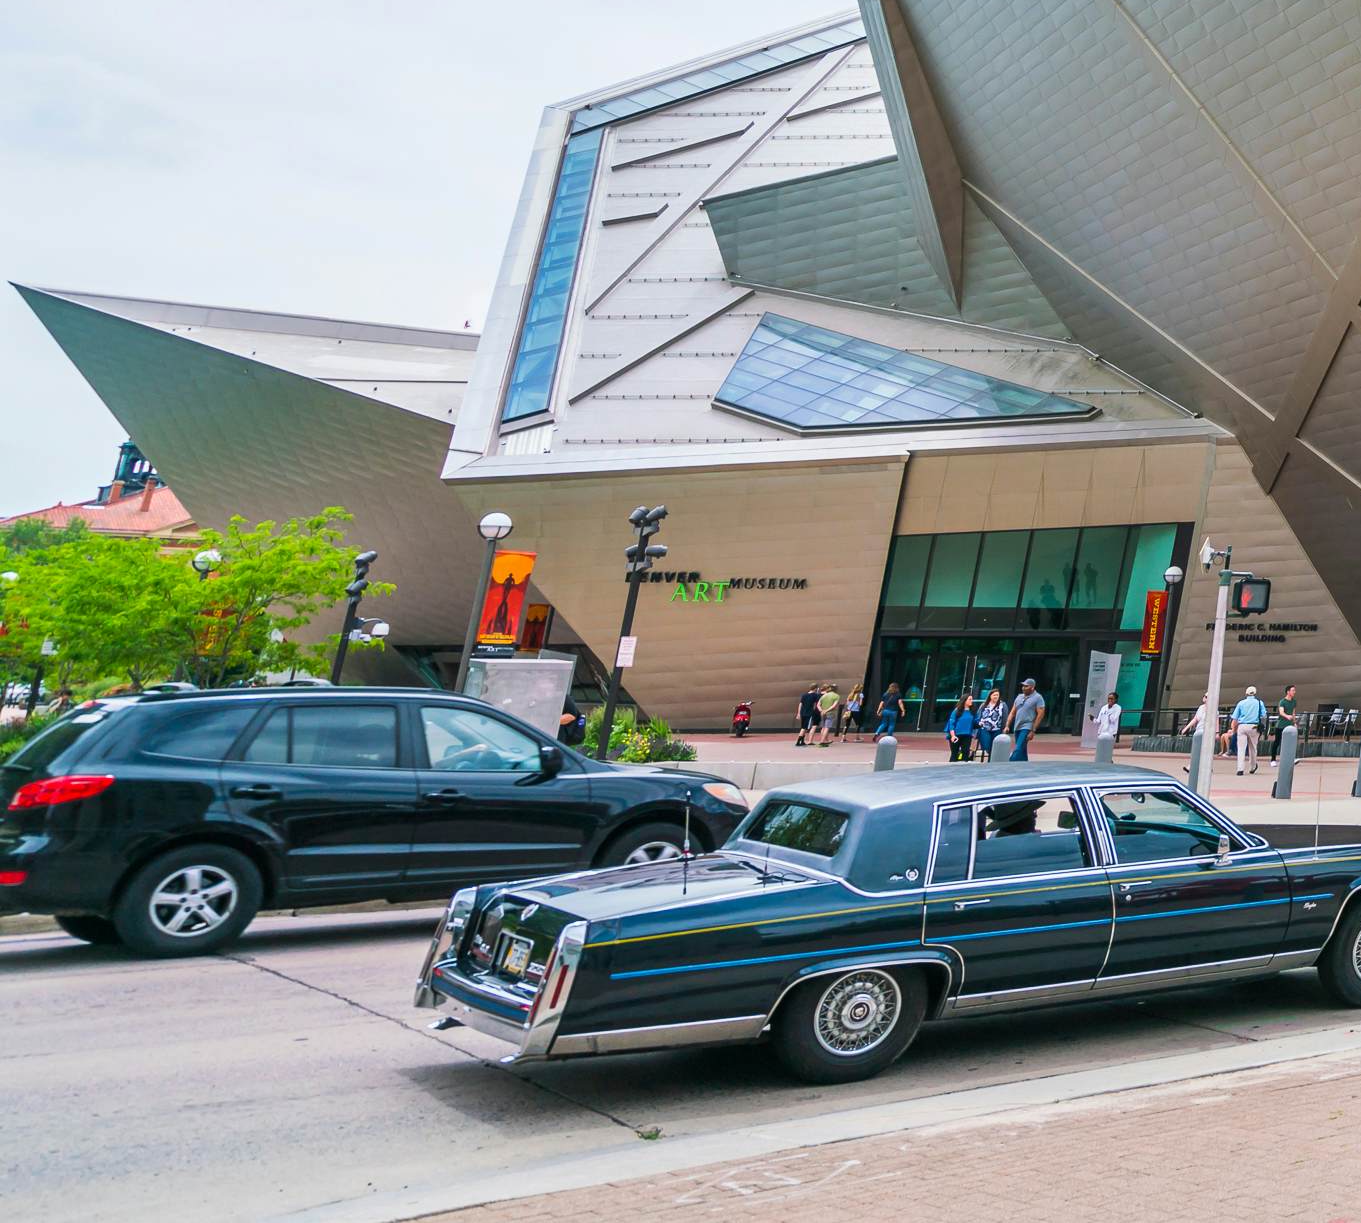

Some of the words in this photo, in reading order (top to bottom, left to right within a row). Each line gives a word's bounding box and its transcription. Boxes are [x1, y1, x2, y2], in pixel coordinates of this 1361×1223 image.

[670, 580, 731, 603] ART
[729, 577, 808, 590] MUSEUM
[1148, 598, 1161, 649] WESTERN
[1206, 623, 1256, 632] FDERIC
[1269, 623, 1318, 632] HAMILTON
[1238, 634, 1286, 643] BUILDING
